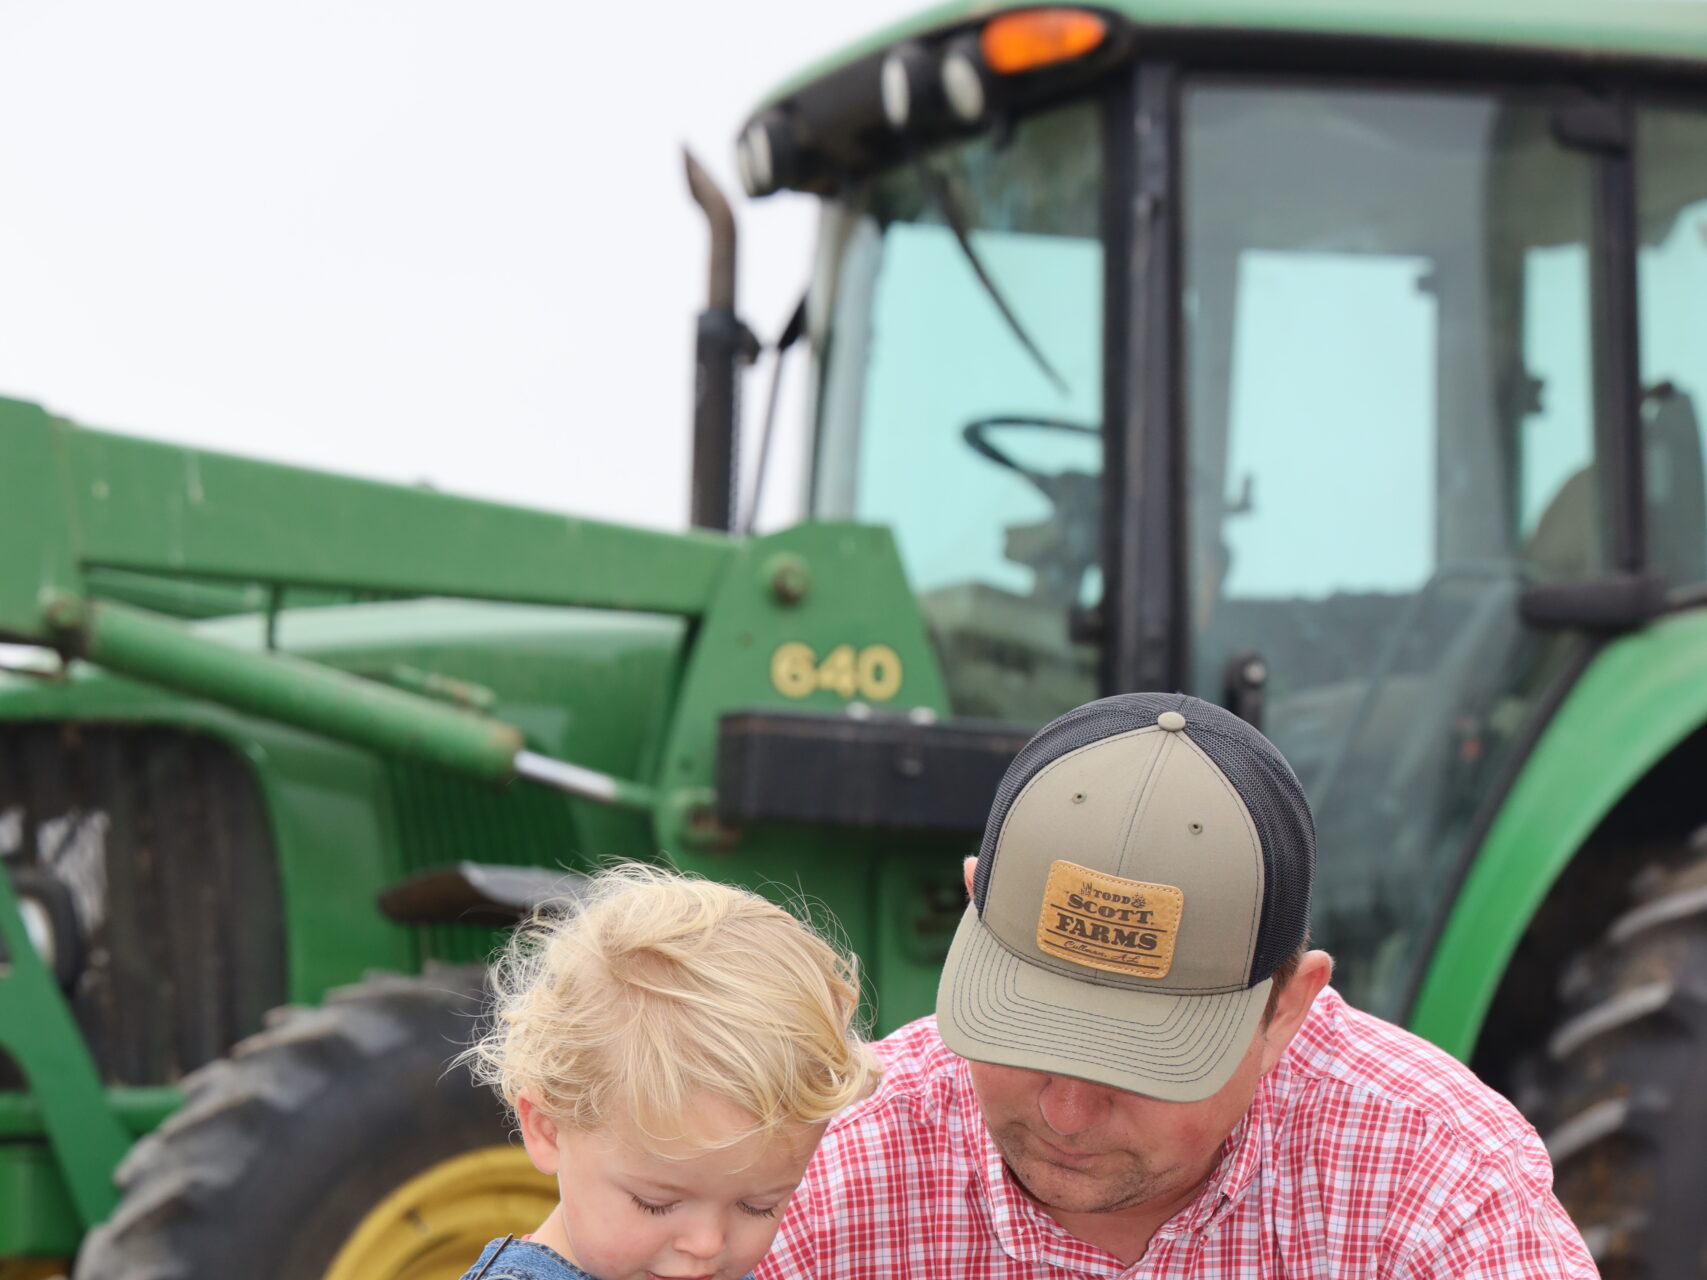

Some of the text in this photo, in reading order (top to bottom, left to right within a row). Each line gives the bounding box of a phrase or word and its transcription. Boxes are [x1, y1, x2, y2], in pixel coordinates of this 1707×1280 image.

[771, 641, 903, 701] 640
[1067, 893, 1154, 924] SCOTT
[1093, 889, 1131, 905] TODD
[1055, 912, 1158, 951] FARMS
